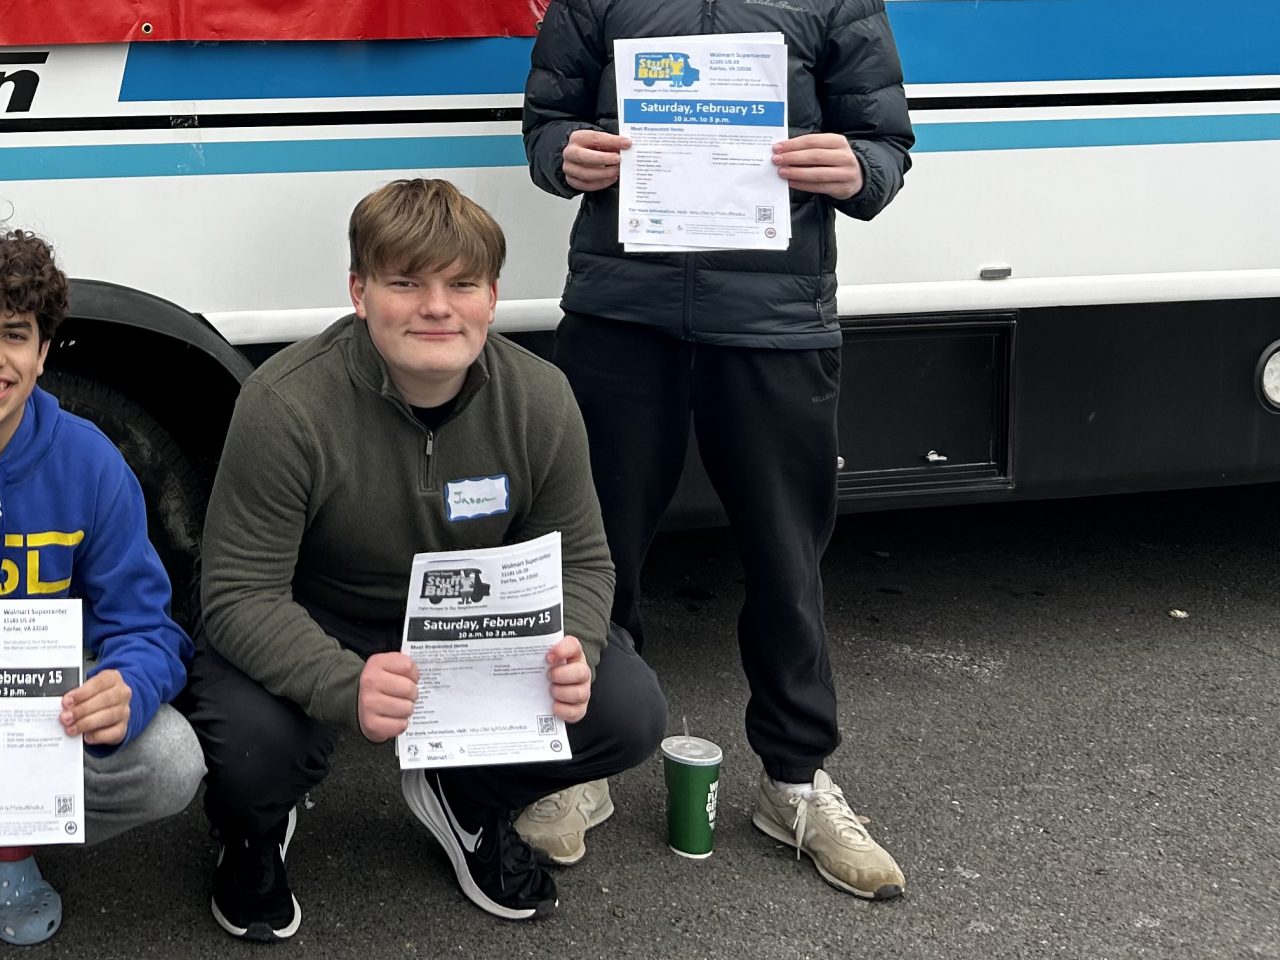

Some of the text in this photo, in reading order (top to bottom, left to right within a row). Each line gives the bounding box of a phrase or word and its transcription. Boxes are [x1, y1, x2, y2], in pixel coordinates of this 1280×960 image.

[641, 102, 765, 118] Saturday, February 15
[426, 575, 461, 586] Stuff
[424, 585, 460, 596] Bus!
[423, 611, 551, 631] Saturday, February 15
[501, 630, 517, 638] p.m.
[48, 670, 63, 684] 15
[3, 687, 8, 696] 3
[10, 688, 27, 698] p.m.
